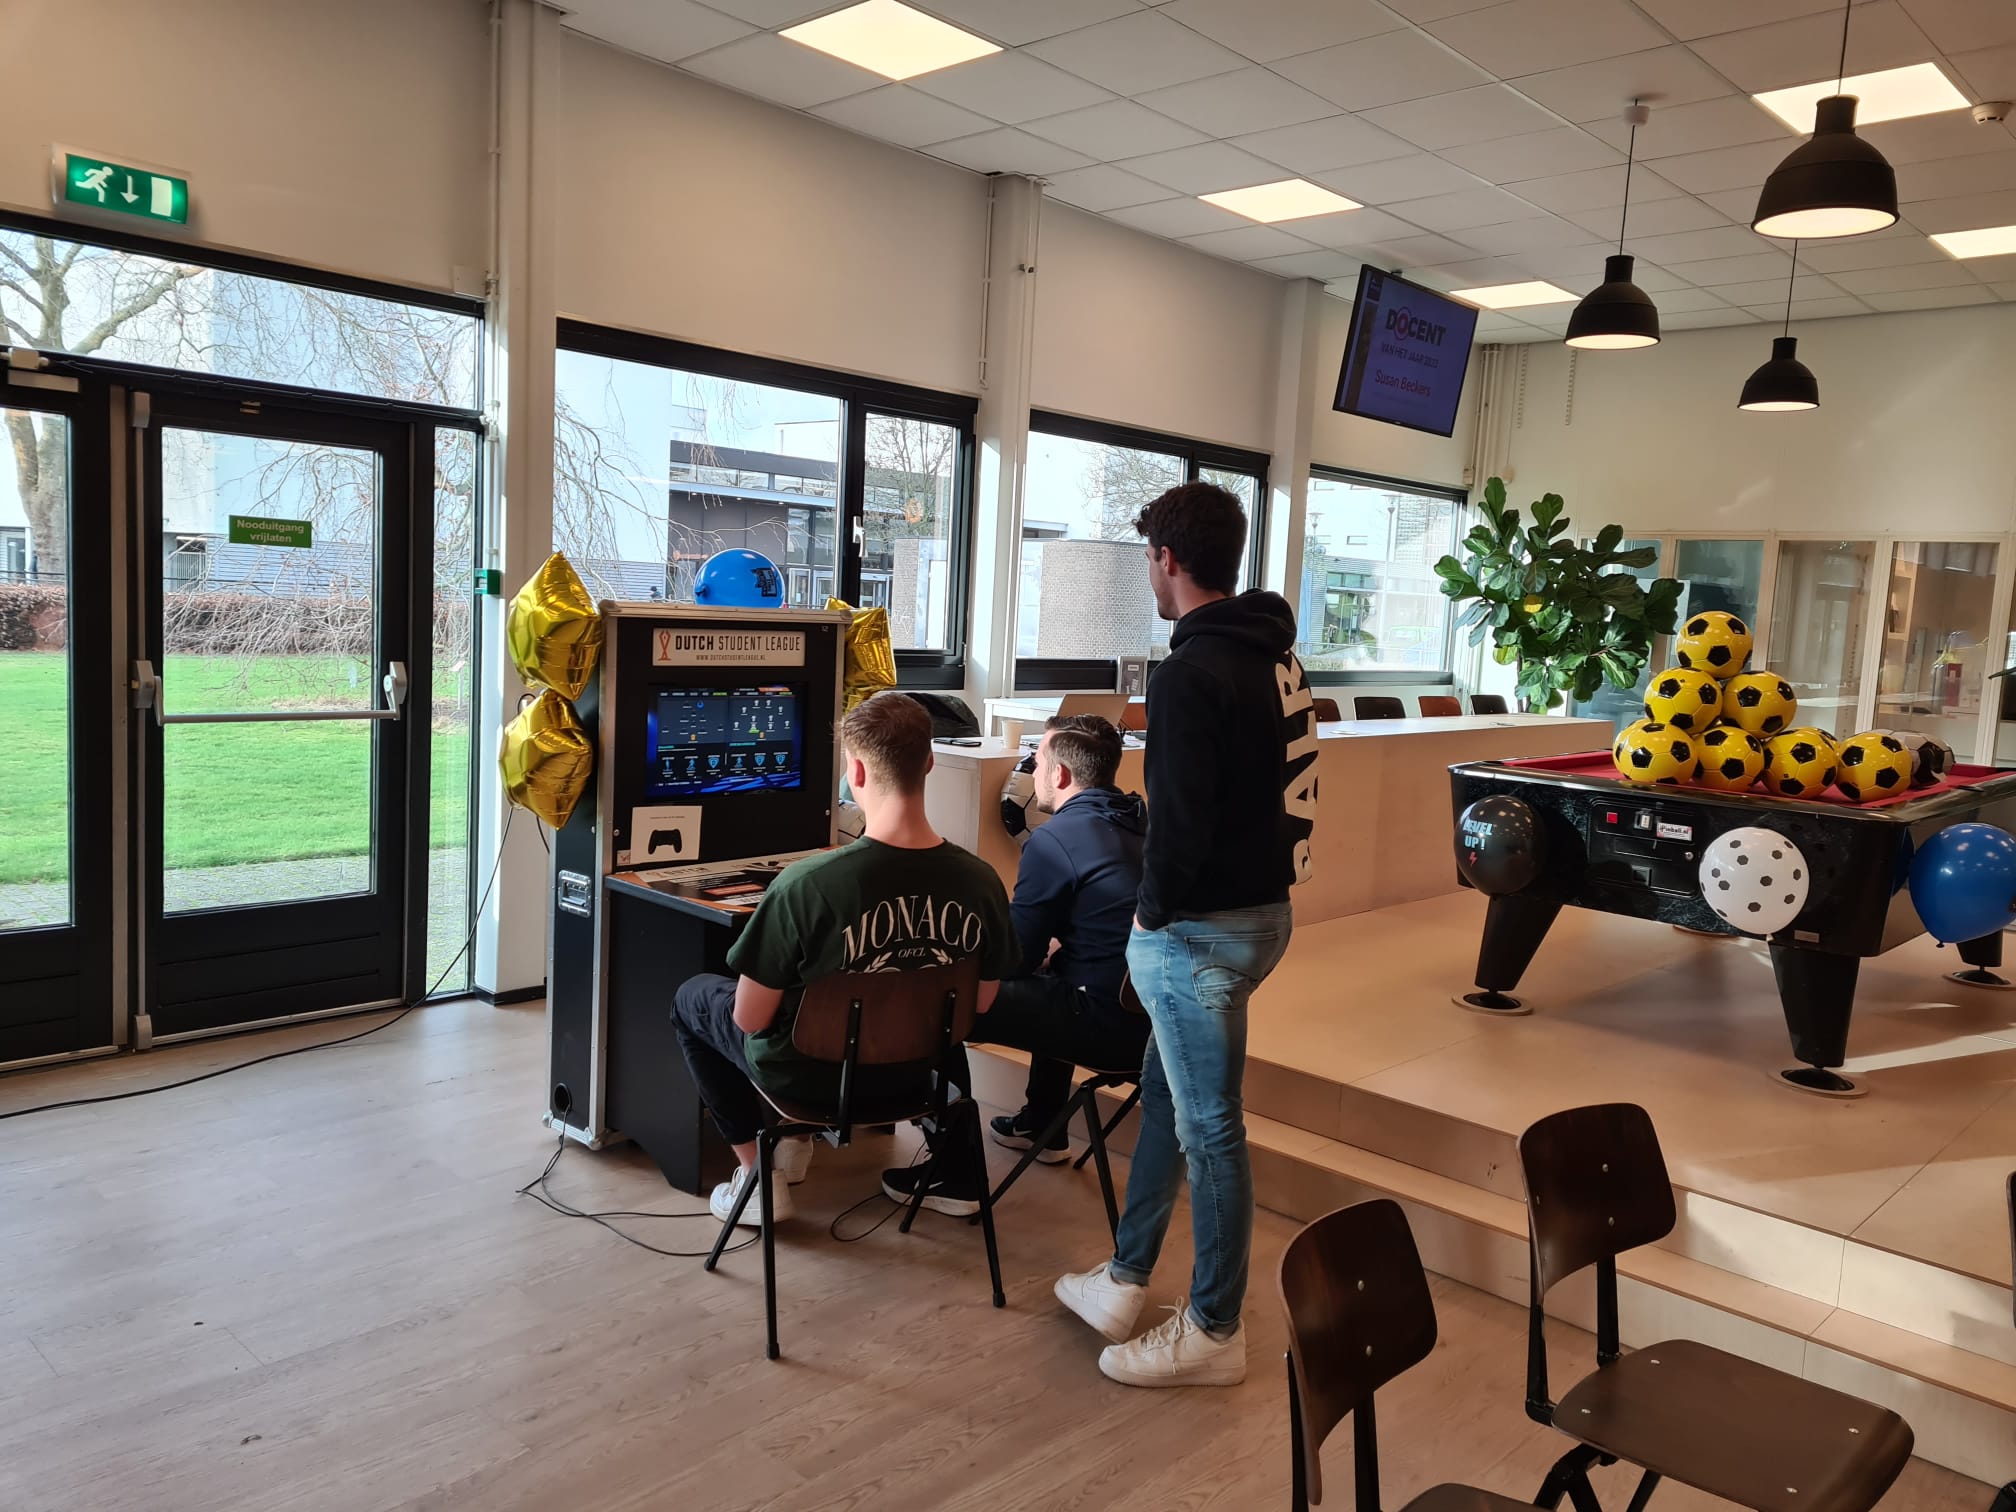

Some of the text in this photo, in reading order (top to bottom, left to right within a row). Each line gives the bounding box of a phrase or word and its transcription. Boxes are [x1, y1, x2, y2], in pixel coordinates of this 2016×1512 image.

[1386, 308, 1446, 346] DOCENT
[1375, 369, 1431, 397] Susan Beckers
[237, 519, 304, 534] Nooduitgang
[250, 532, 292, 543] vrijlaten
[675, 635, 801, 651] DUTCH STUDENT LEAGUE
[1463, 817, 1493, 836] LEVEL
[840, 895, 982, 970] MONACO
